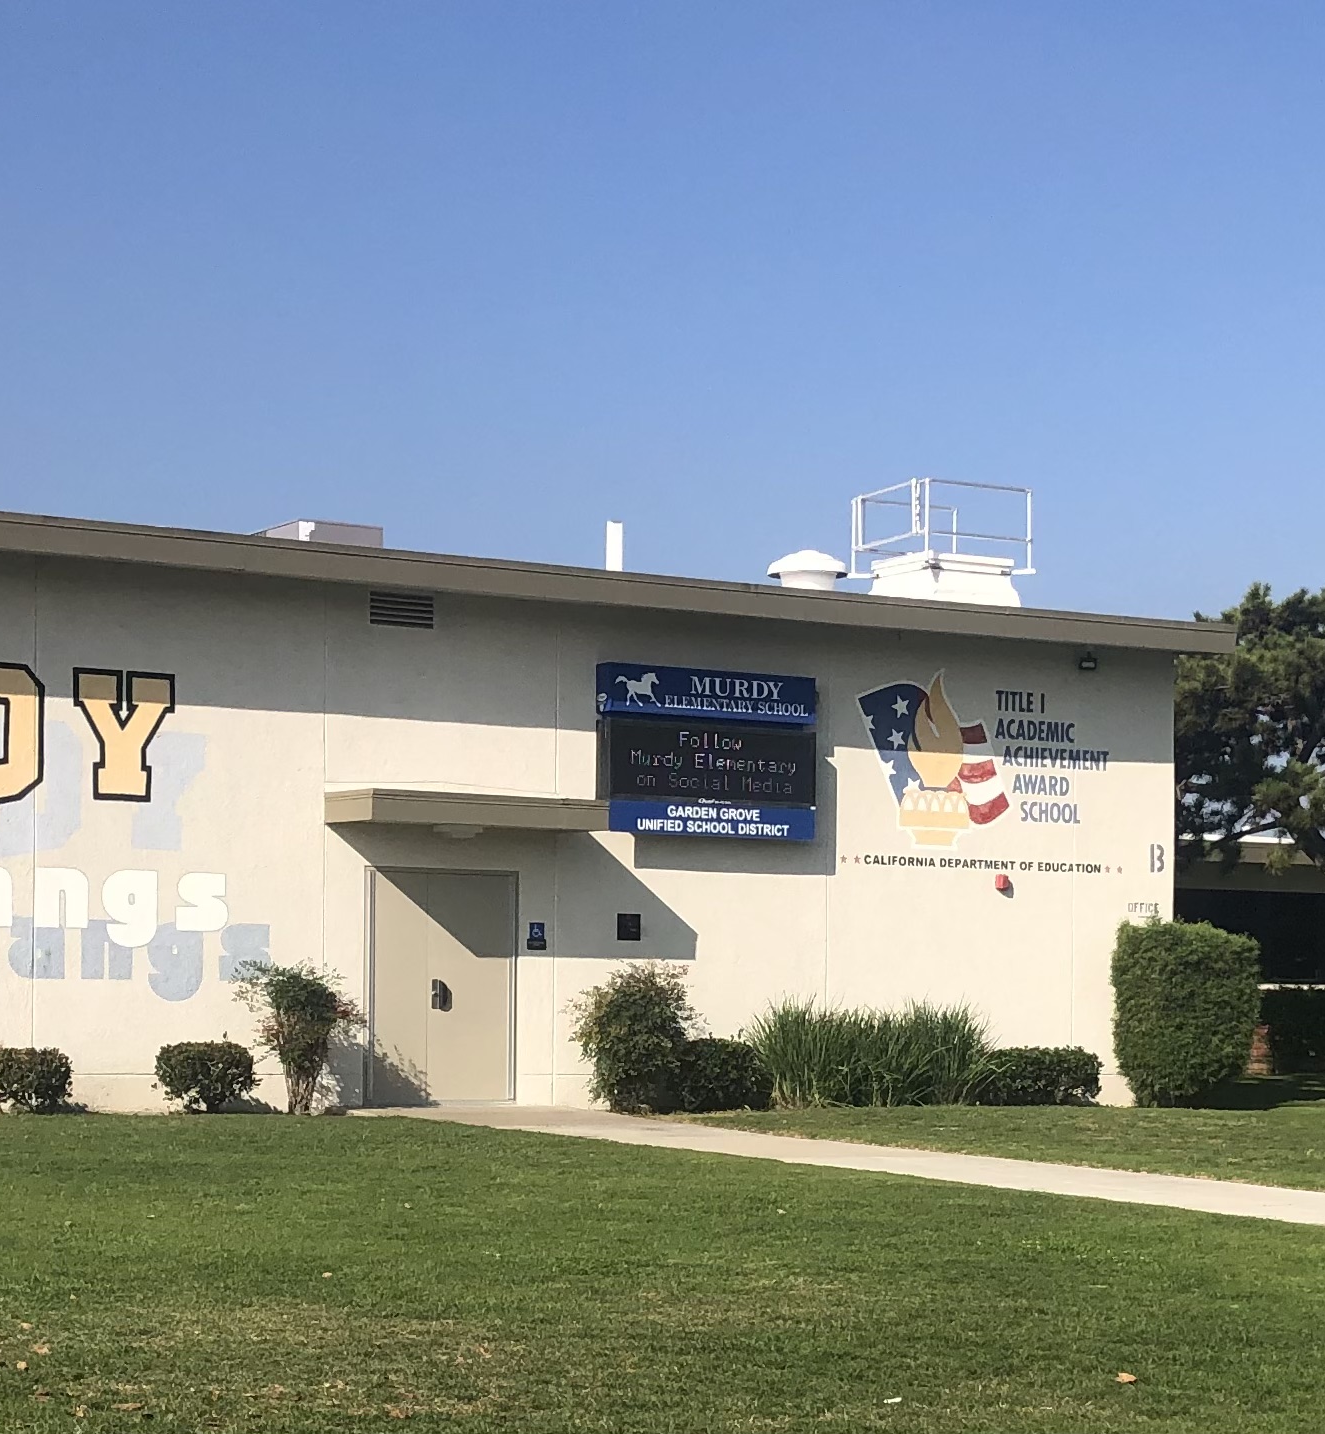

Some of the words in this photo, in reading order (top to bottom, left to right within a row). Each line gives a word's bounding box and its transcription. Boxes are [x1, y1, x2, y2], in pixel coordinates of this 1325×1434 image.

[689, 675, 784, 700] MURDY
[664, 694, 754, 714] ELEMENTARY
[757, 702, 809, 717] SCHOOL
[996, 690, 1034, 713] TITLE
[1040, 693, 1046, 714] I
[679, 731, 743, 751] Follow
[995, 718, 1076, 744] ACADEMIC
[630, 749, 683, 770] Murdy
[694, 753, 796, 776] Elementary
[1002, 745, 1110, 772] ACHIEVEMENT
[636, 774, 657, 788] on
[668, 773, 730, 792] Social
[741, 776, 793, 795] Media
[1012, 773, 1070, 797] AWARD
[667, 805, 717, 820] GARDEN
[720, 807, 761, 821] GROVE
[1019, 801, 1081, 824] SCHOOL
[637, 818, 684, 832] UNIFIED
[686, 820, 735, 835] SCHOOL
[737, 822, 790, 837] DISTRICT
[863, 854, 936, 868] CALIFORNIA
[939, 857, 1016, 871] DEPARTMENT
[1019, 861, 1034, 872] OF
[1037, 861, 1102, 874] EDUCATION
[1149, 843, 1165, 873] B
[1127, 902, 1160, 914] OFFICE
